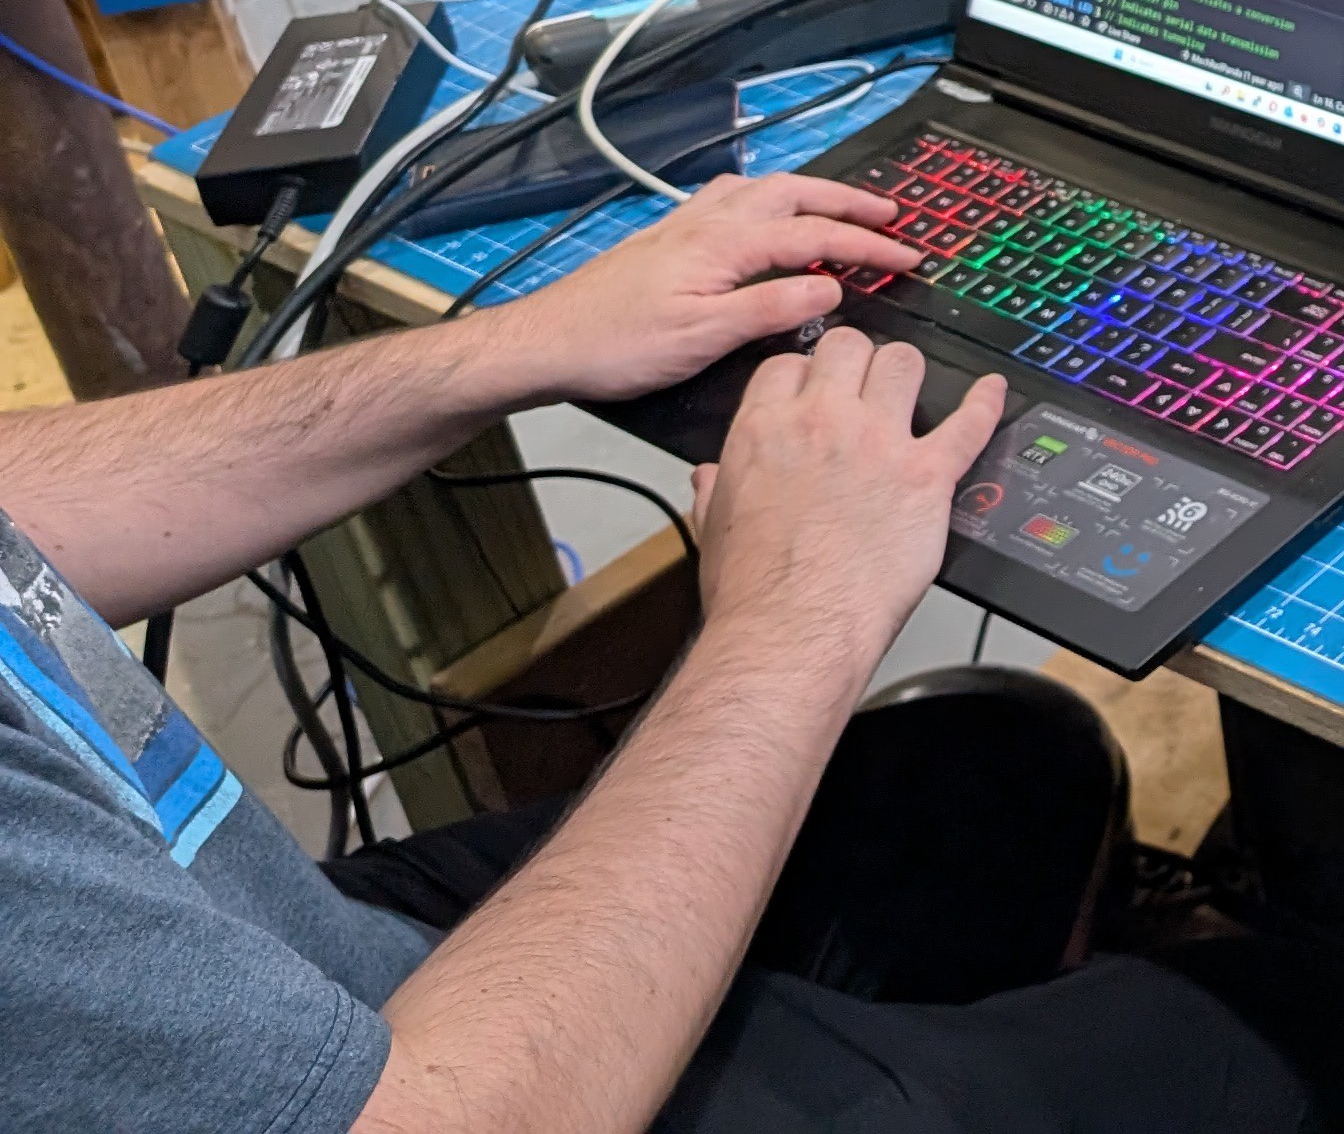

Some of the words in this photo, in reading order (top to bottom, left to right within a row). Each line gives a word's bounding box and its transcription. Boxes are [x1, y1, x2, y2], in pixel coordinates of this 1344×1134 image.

[1219, 32, 1279, 60] transmission
[1265, 606, 1284, 619] 72
[1304, 623, 1322, 637] 74
